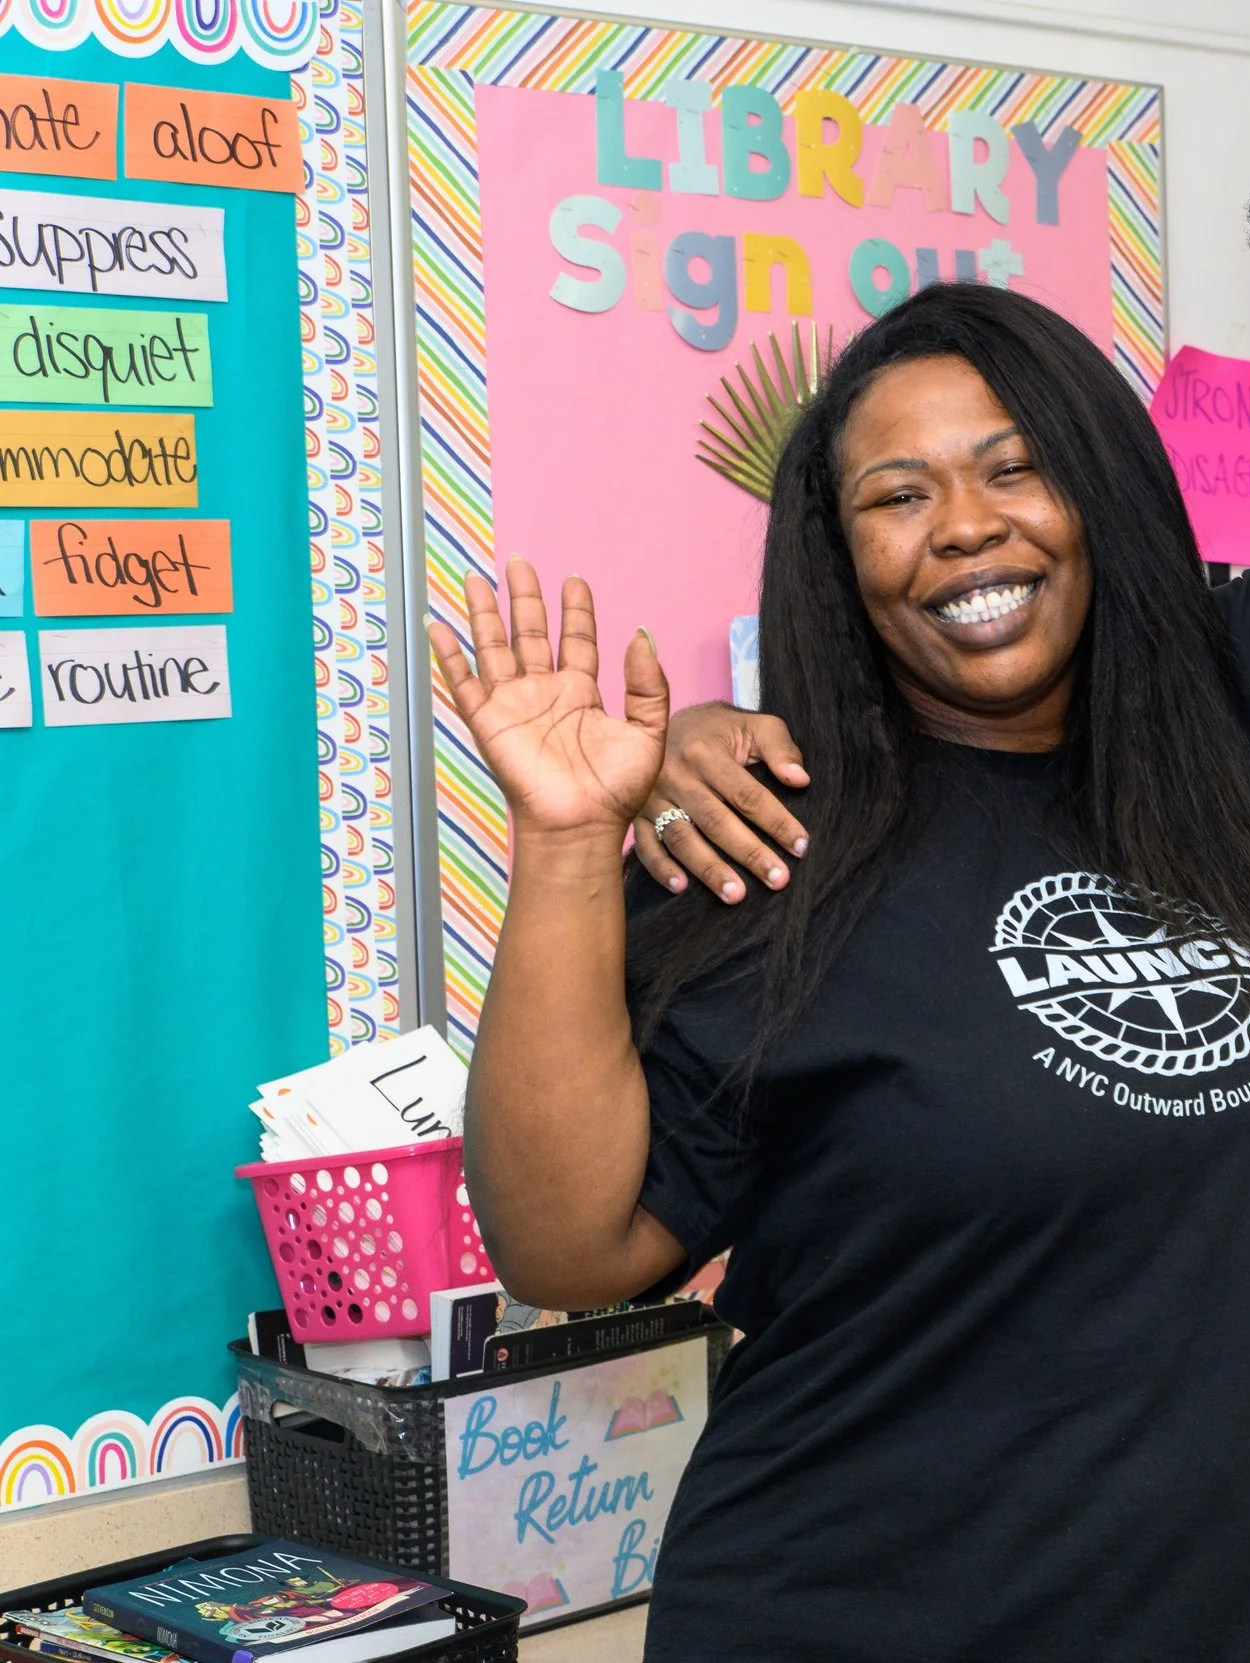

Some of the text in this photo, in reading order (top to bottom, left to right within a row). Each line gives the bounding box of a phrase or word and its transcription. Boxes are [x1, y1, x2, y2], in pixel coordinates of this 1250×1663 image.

[153, 102, 282, 169] aloof
[595, 68, 1083, 227] LIBRARY
[549, 191, 1024, 351] Sign out
[13, 315, 200, 403] disquiet
[43, 522, 211, 607] fidget
[47, 650, 221, 704] routine
[1032, 1046, 1058, 1069] A
[1056, 1056, 1110, 1097] NYC
[1113, 1082, 1205, 1117] Outward
[457, 1380, 570, 1480] Book
[514, 1455, 654, 1544] Return
[129, 1552, 322, 1607] NIMONA
